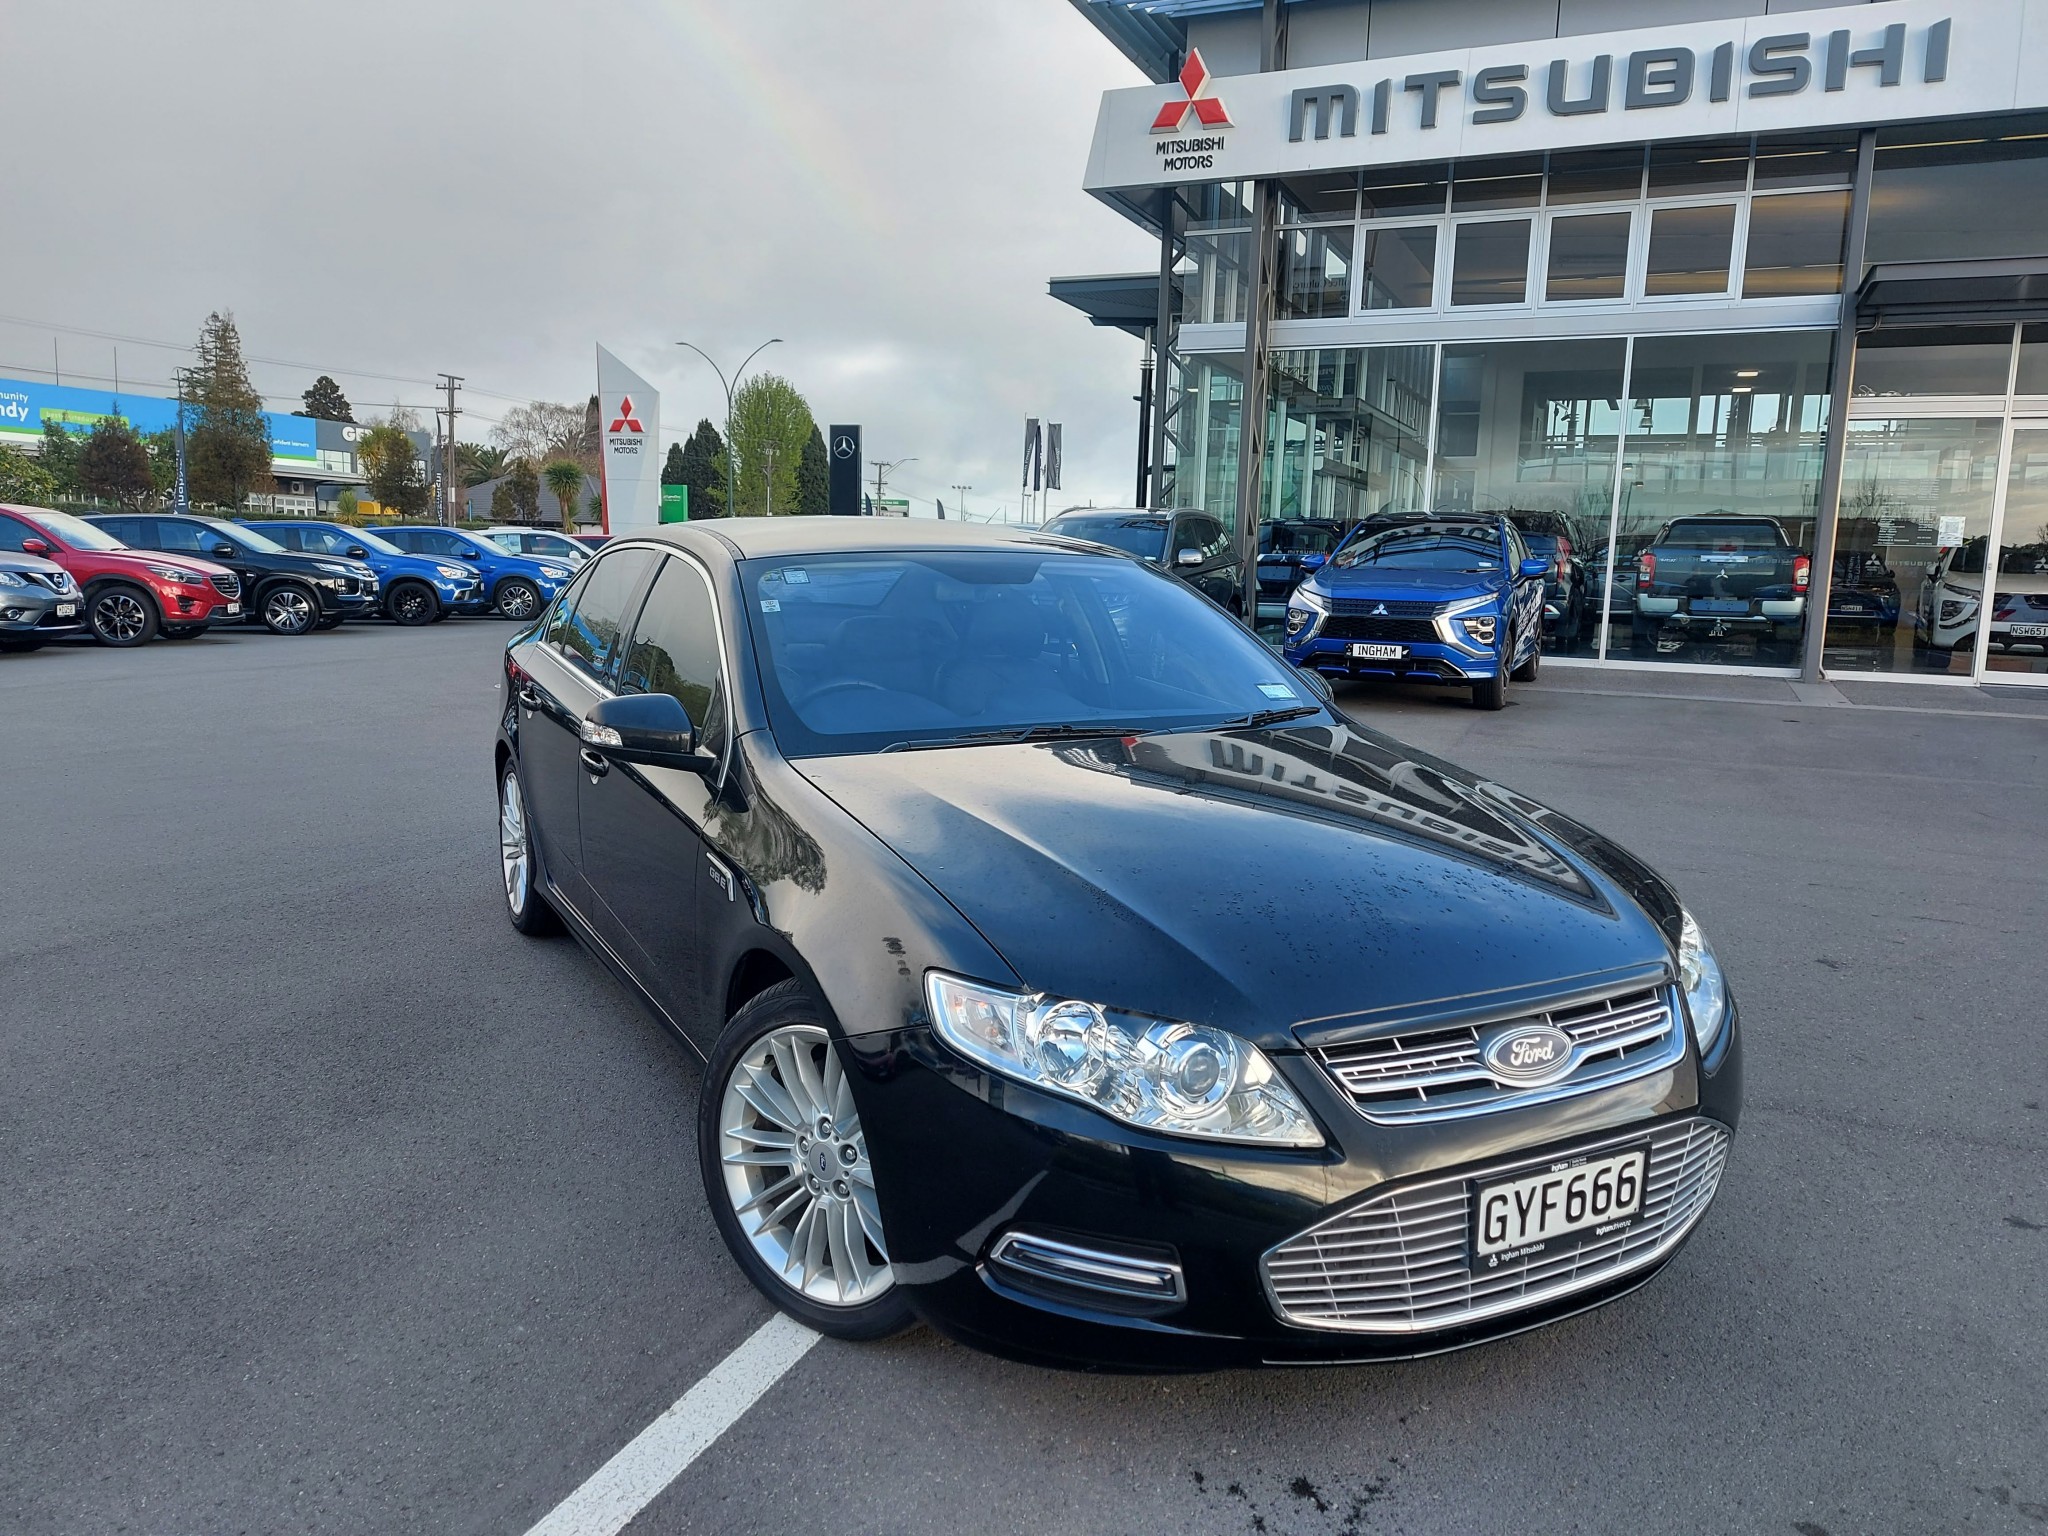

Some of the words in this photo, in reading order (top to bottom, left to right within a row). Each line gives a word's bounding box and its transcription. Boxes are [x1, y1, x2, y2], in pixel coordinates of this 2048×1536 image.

[1289, 16, 1951, 143] MITSUBISHI
[1155, 137, 1226, 156] MITSUBISHI
[1163, 154, 1214, 170] MOTORS
[0, 391, 29, 404] unity
[609, 438, 643, 446] MITSUBISHI
[613, 446, 638, 455] MOTORS
[1510, 1036, 1554, 1067] Ford
[1484, 1159, 1637, 1245] GYF666
[1501, 1250, 1520, 1262] Ingham
[1520, 1242, 1545, 1257] Mitsubishi
